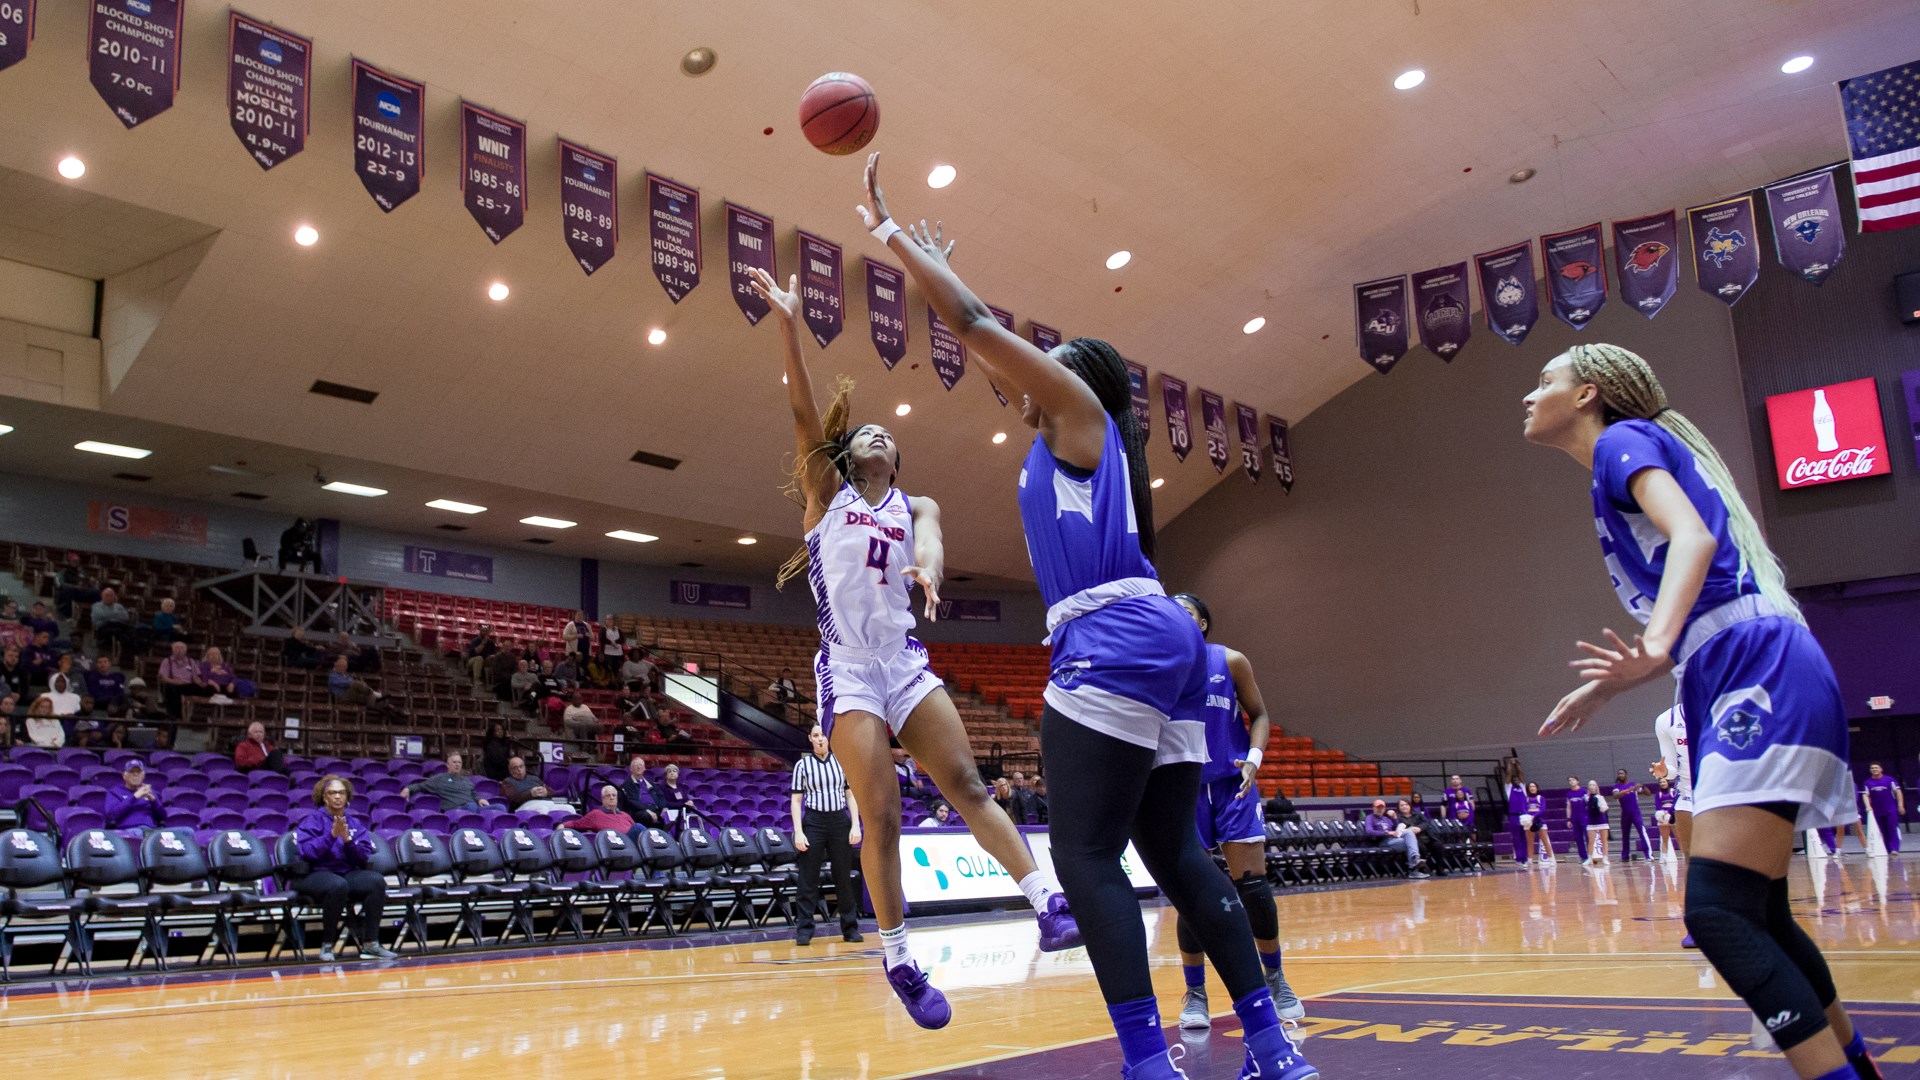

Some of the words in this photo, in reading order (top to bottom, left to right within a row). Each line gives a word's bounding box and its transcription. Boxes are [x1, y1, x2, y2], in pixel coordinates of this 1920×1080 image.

[97, 4, 142, 27] BLOCKED
[144, 21, 174, 39] SHOTS
[106, 20, 164, 48] CHAMPIONS
[98, 37, 165, 74] 2010-11
[260, 48, 282, 63] NCAA
[234, 54, 275, 75] BLOCKED
[276, 69, 303, 87] SHOTS
[246, 70, 293, 93] CHAMPION
[111, 72, 136, 88] 7.0
[137, 82, 153, 96] PG
[243, 81, 293, 106] WILLIAM
[237, 90, 298, 119] MOSLEY
[236, 105, 296, 139] 2010-11
[357, 115, 416, 143] TOURNAMENT
[247, 132, 271, 149] 4.9
[272, 142, 287, 155] PG
[357, 134, 415, 166] 2012-13
[478, 135, 510, 160] WNIT
[366, 160, 405, 182] 23-9
[469, 167, 520, 198] 1985-86
[564, 176, 611, 199] TOURNAMENT
[477, 195, 511, 215] 25-7
[564, 202, 612, 230] 1988-89
[653, 209, 693, 230] REBOUNDING
[657, 220, 690, 238] CHAMPION
[1783, 213, 1797, 229] NEW
[1797, 208, 1829, 219] ORLEANS
[572, 228, 603, 248] 22-8
[653, 238, 694, 260] HUDSON
[667, 234, 682, 245] PAM
[738, 231, 762, 251] WNIT
[653, 251, 697, 275] 1989-90
[810, 258, 833, 278] WNIT
[661, 273, 678, 286] 15.1
[803, 286, 839, 309] 1994-95
[875, 284, 896, 303] WNIT
[809, 307, 834, 324] 25-7
[870, 310, 903, 332] 1998-99
[1369, 319, 1396, 334] ACU
[876, 331, 898, 347] 22-7
[932, 347, 961, 366] 2001-02
[1171, 427, 1188, 448] 10
[1208, 440, 1227, 461] 25
[1242, 451, 1260, 472] 33
[1274, 462, 1293, 483] 45
[1785, 445, 1876, 485] Coca-Cola
[108, 506, 129, 532] S
[420, 549, 437, 574] T
[865, 535, 890, 586] 4
[682, 583, 700, 604] U
[395, 739, 407, 755] F
[552, 746, 564, 760] G
